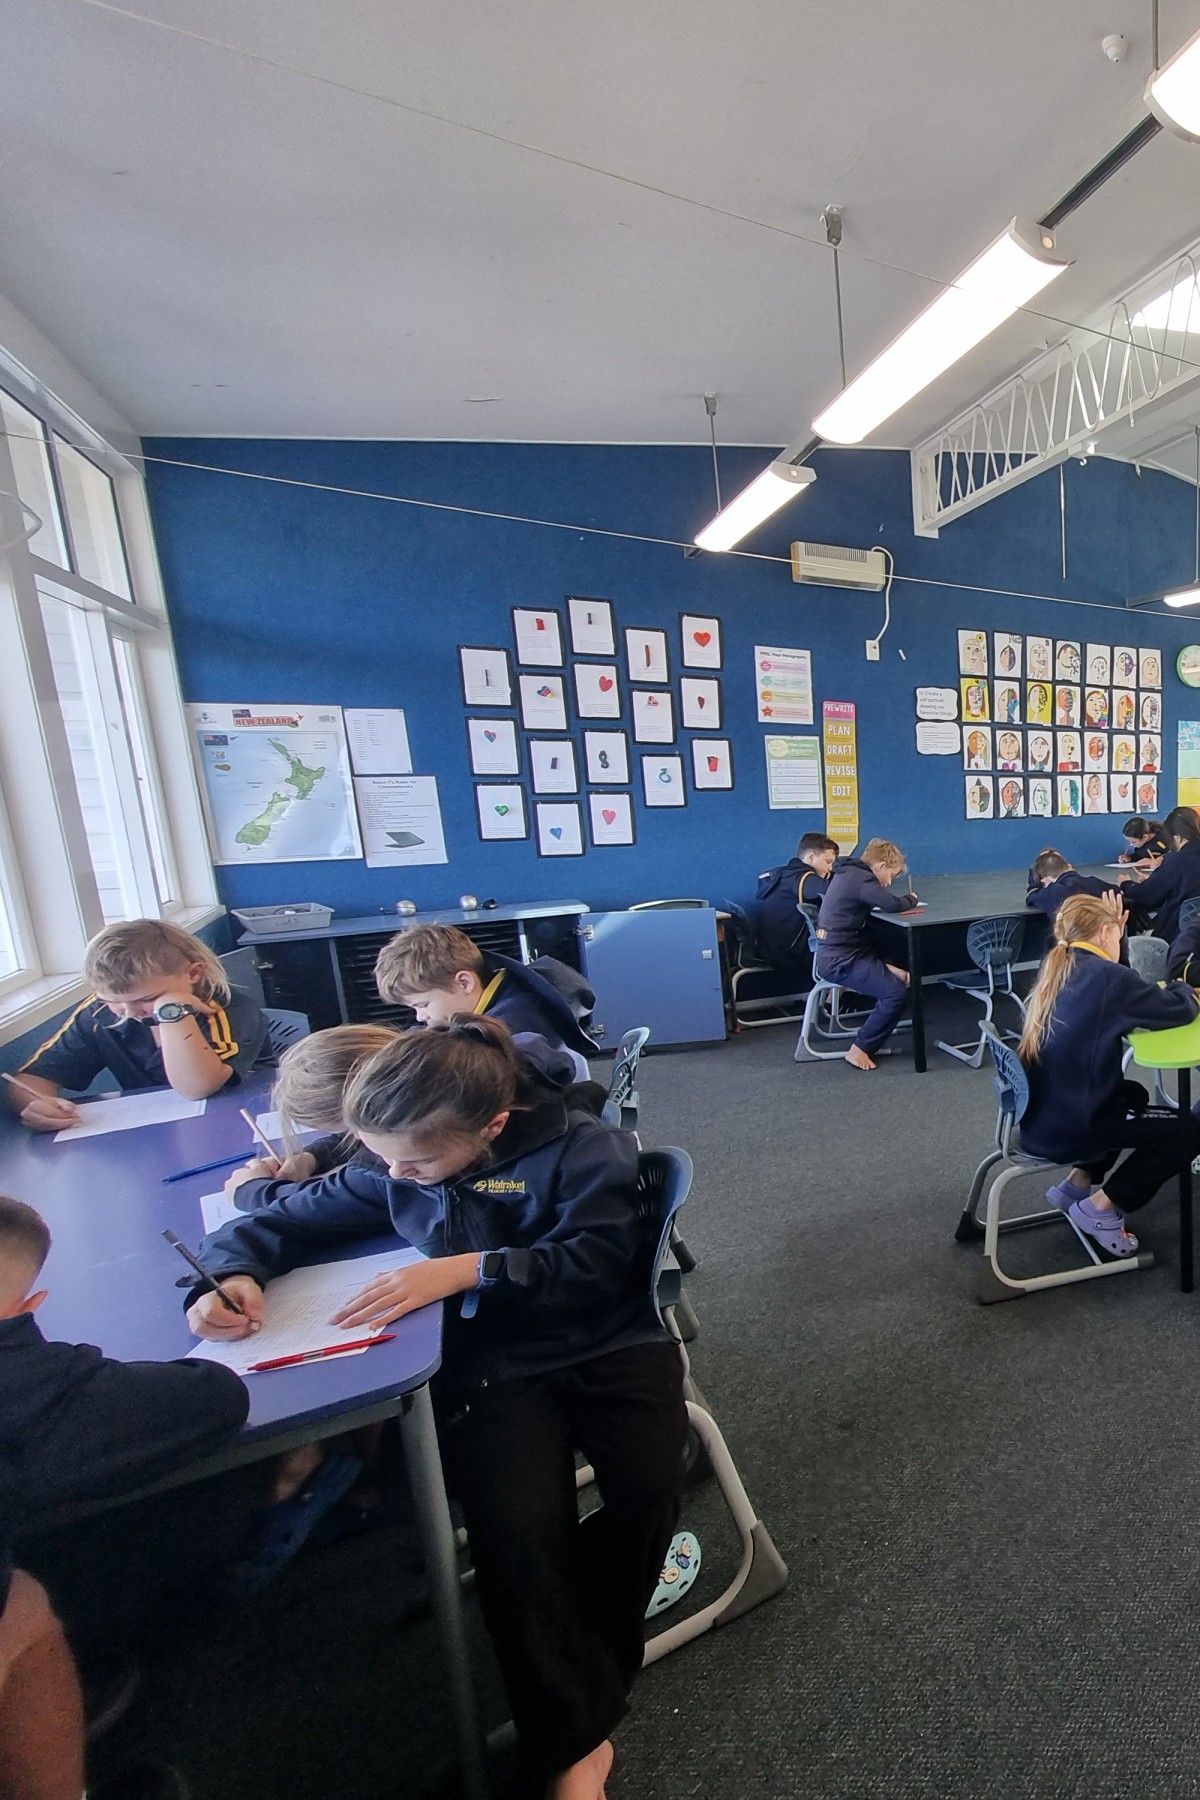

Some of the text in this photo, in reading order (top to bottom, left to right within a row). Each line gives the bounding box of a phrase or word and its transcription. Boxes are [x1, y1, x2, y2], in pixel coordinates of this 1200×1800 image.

[824, 704, 854, 713] PREWRITE
[235, 717, 293, 726] NEW ZEALAND
[828, 724, 850, 736] PLAN
[827, 745, 852, 755] DRAFT
[825, 765, 855, 776] REVISE
[832, 785, 851, 796] EDIT
